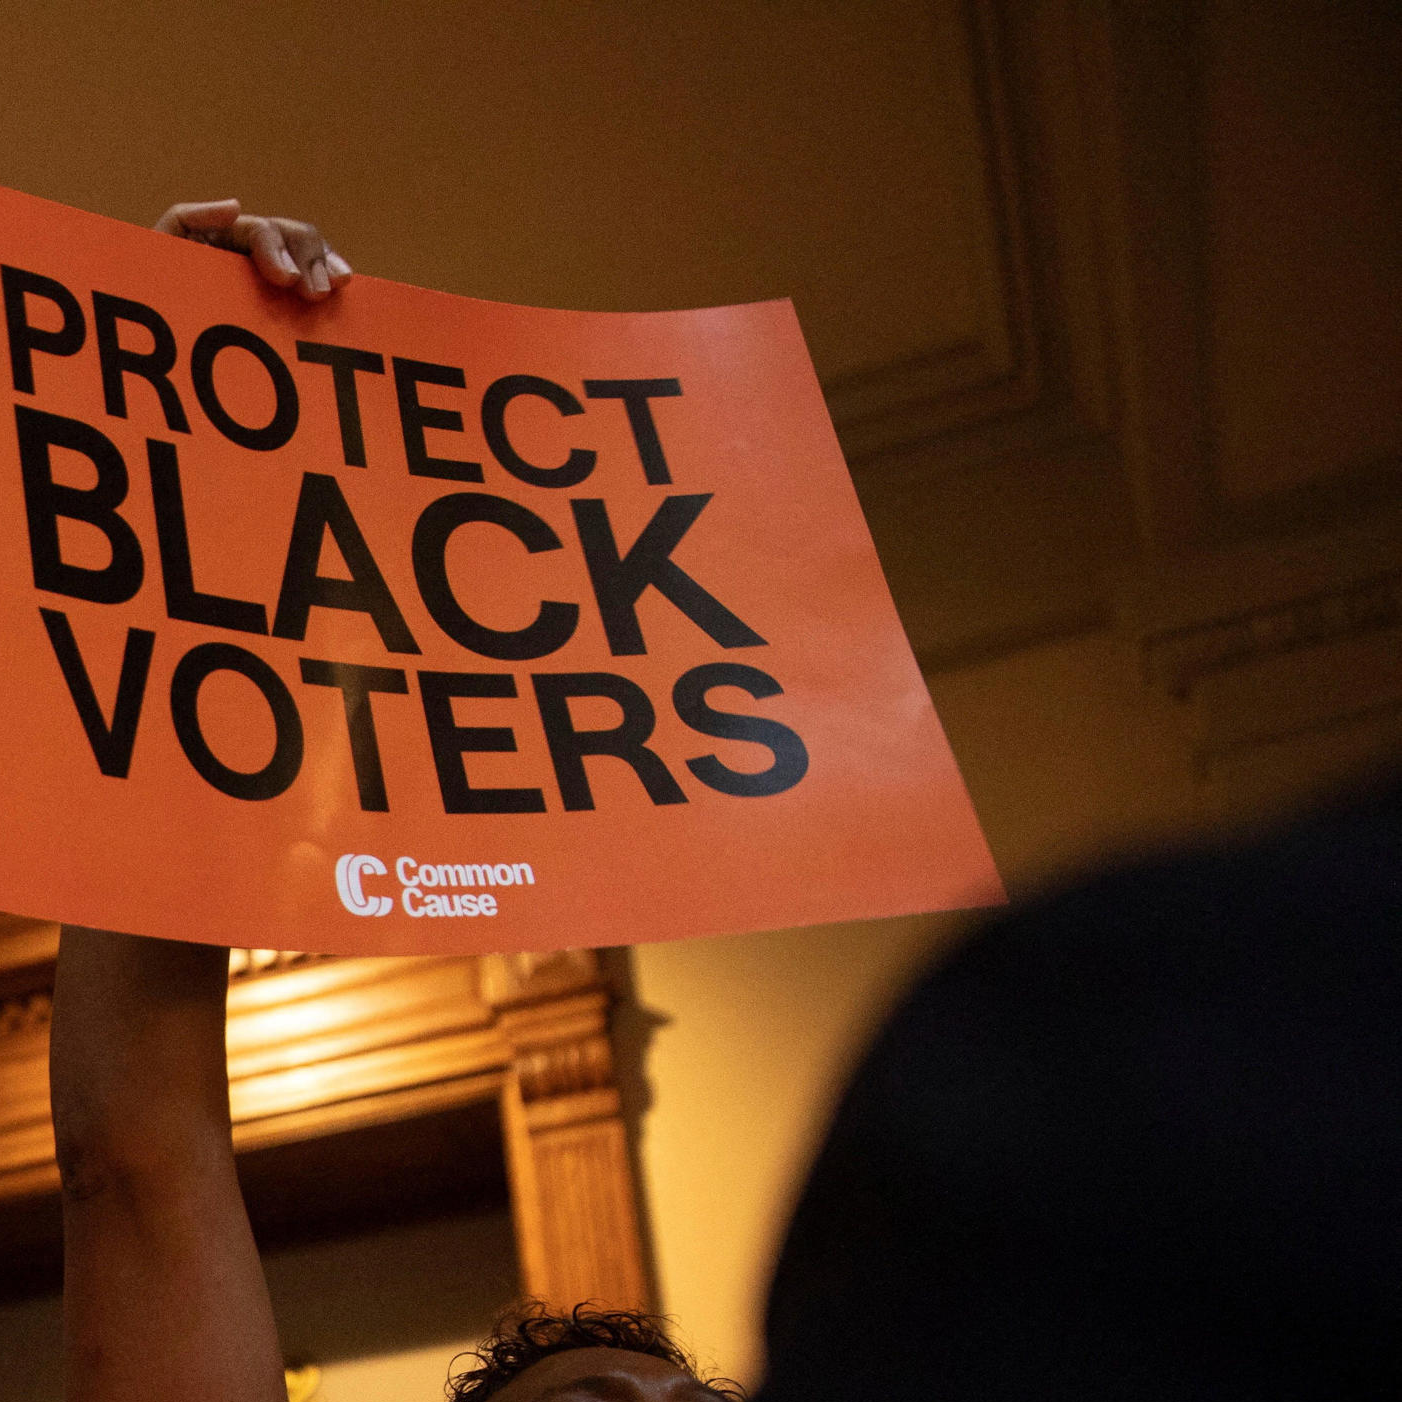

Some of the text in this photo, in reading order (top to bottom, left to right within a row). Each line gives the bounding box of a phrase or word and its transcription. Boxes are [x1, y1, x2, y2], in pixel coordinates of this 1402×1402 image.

[0, 263, 683, 490] PROTECT
[13, 402, 770, 661] BLACK
[37, 605, 810, 815] VOTERS
[394, 855, 537, 889] Common
[401, 886, 500, 919] Cause
